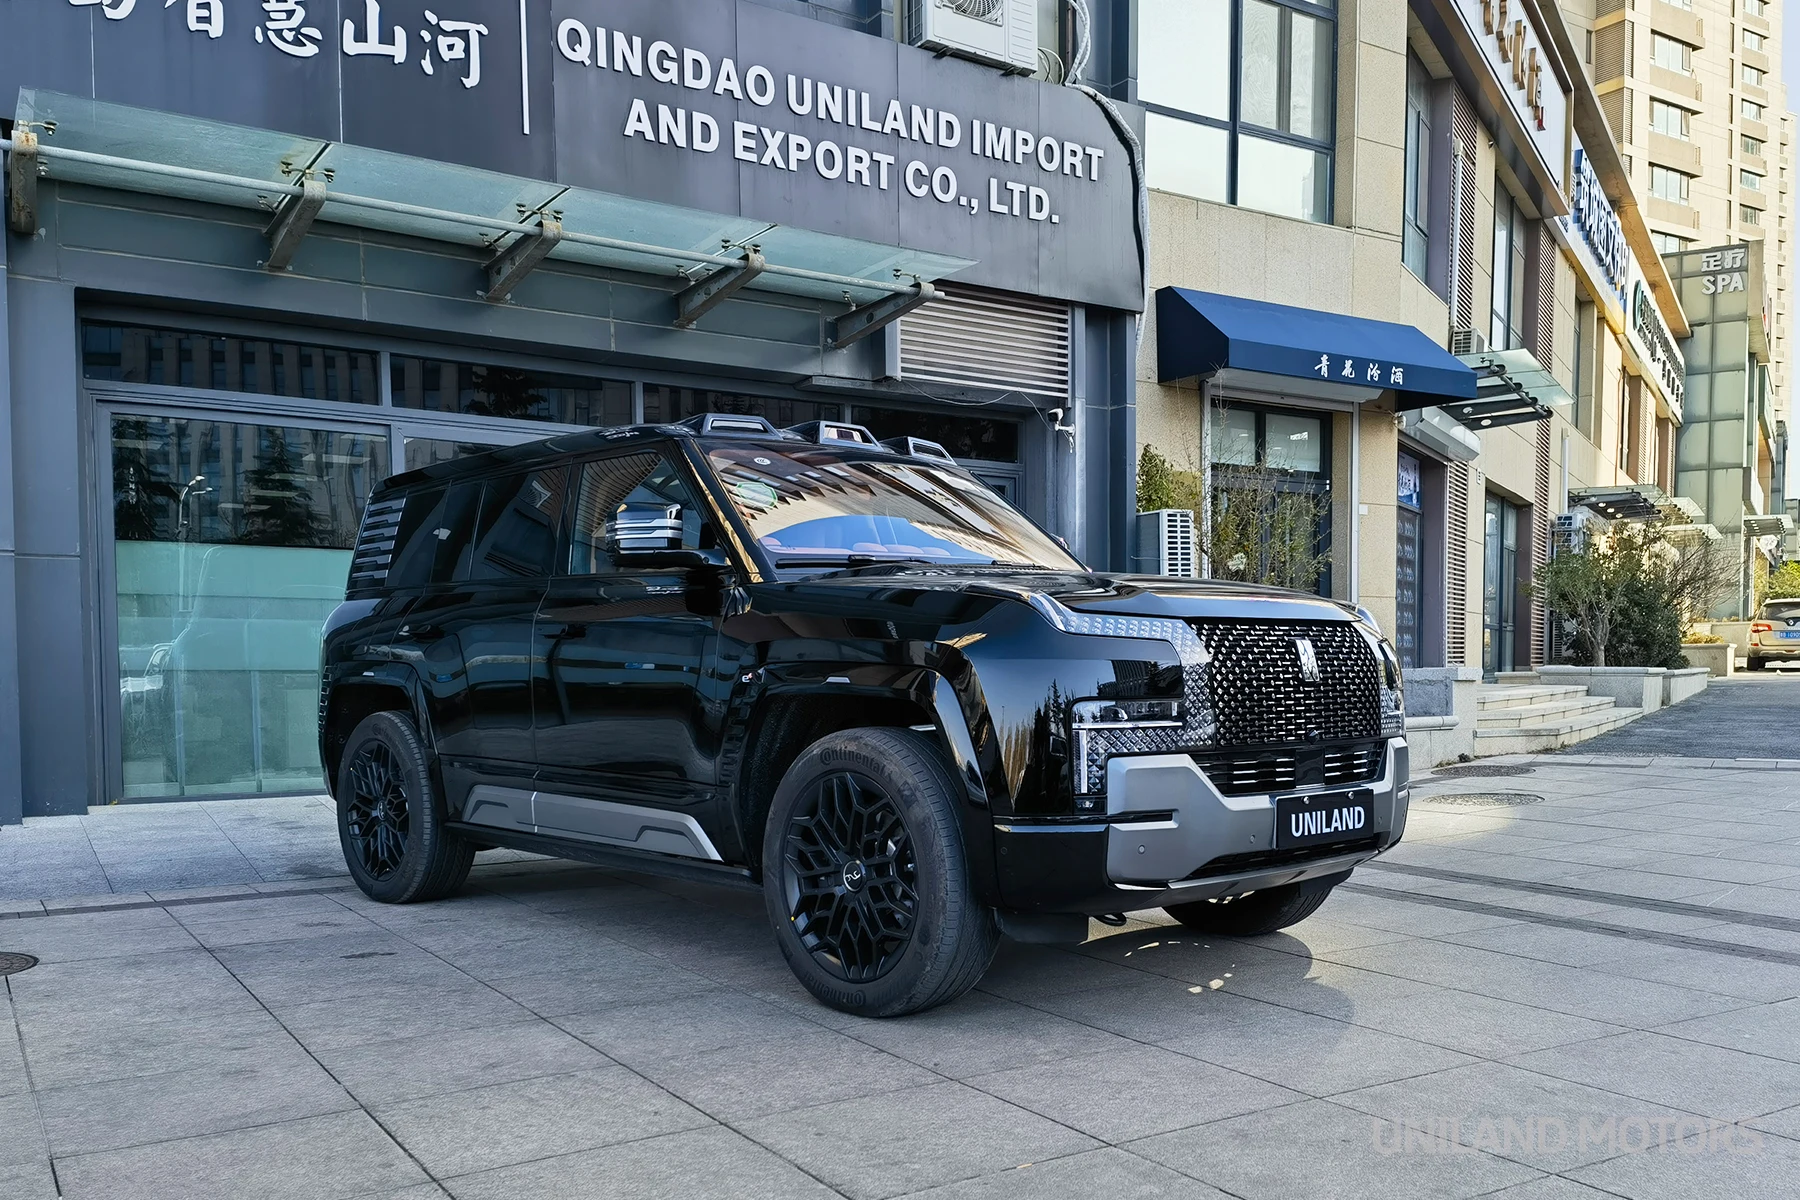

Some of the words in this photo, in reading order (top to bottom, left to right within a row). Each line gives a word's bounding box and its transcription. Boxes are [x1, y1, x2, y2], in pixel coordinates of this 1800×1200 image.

[68, 0, 489, 89] 慧山河
[557, 18, 776, 106] QINGDAO
[786, 74, 961, 148] UNILAND
[971, 119, 1104, 181] IMPORT
[623, 98, 720, 153] AND
[733, 120, 895, 190] EXPORT
[904, 160, 979, 214] CO.,
[988, 177, 1060, 223] LTD.
[1701, 248, 1746, 272] 足疗
[1701, 272, 1744, 295] SPA
[1314, 354, 1404, 385] 青花汾酒
[820, 747, 887, 777] Continental
[1291, 806, 1365, 837] UNILAND
